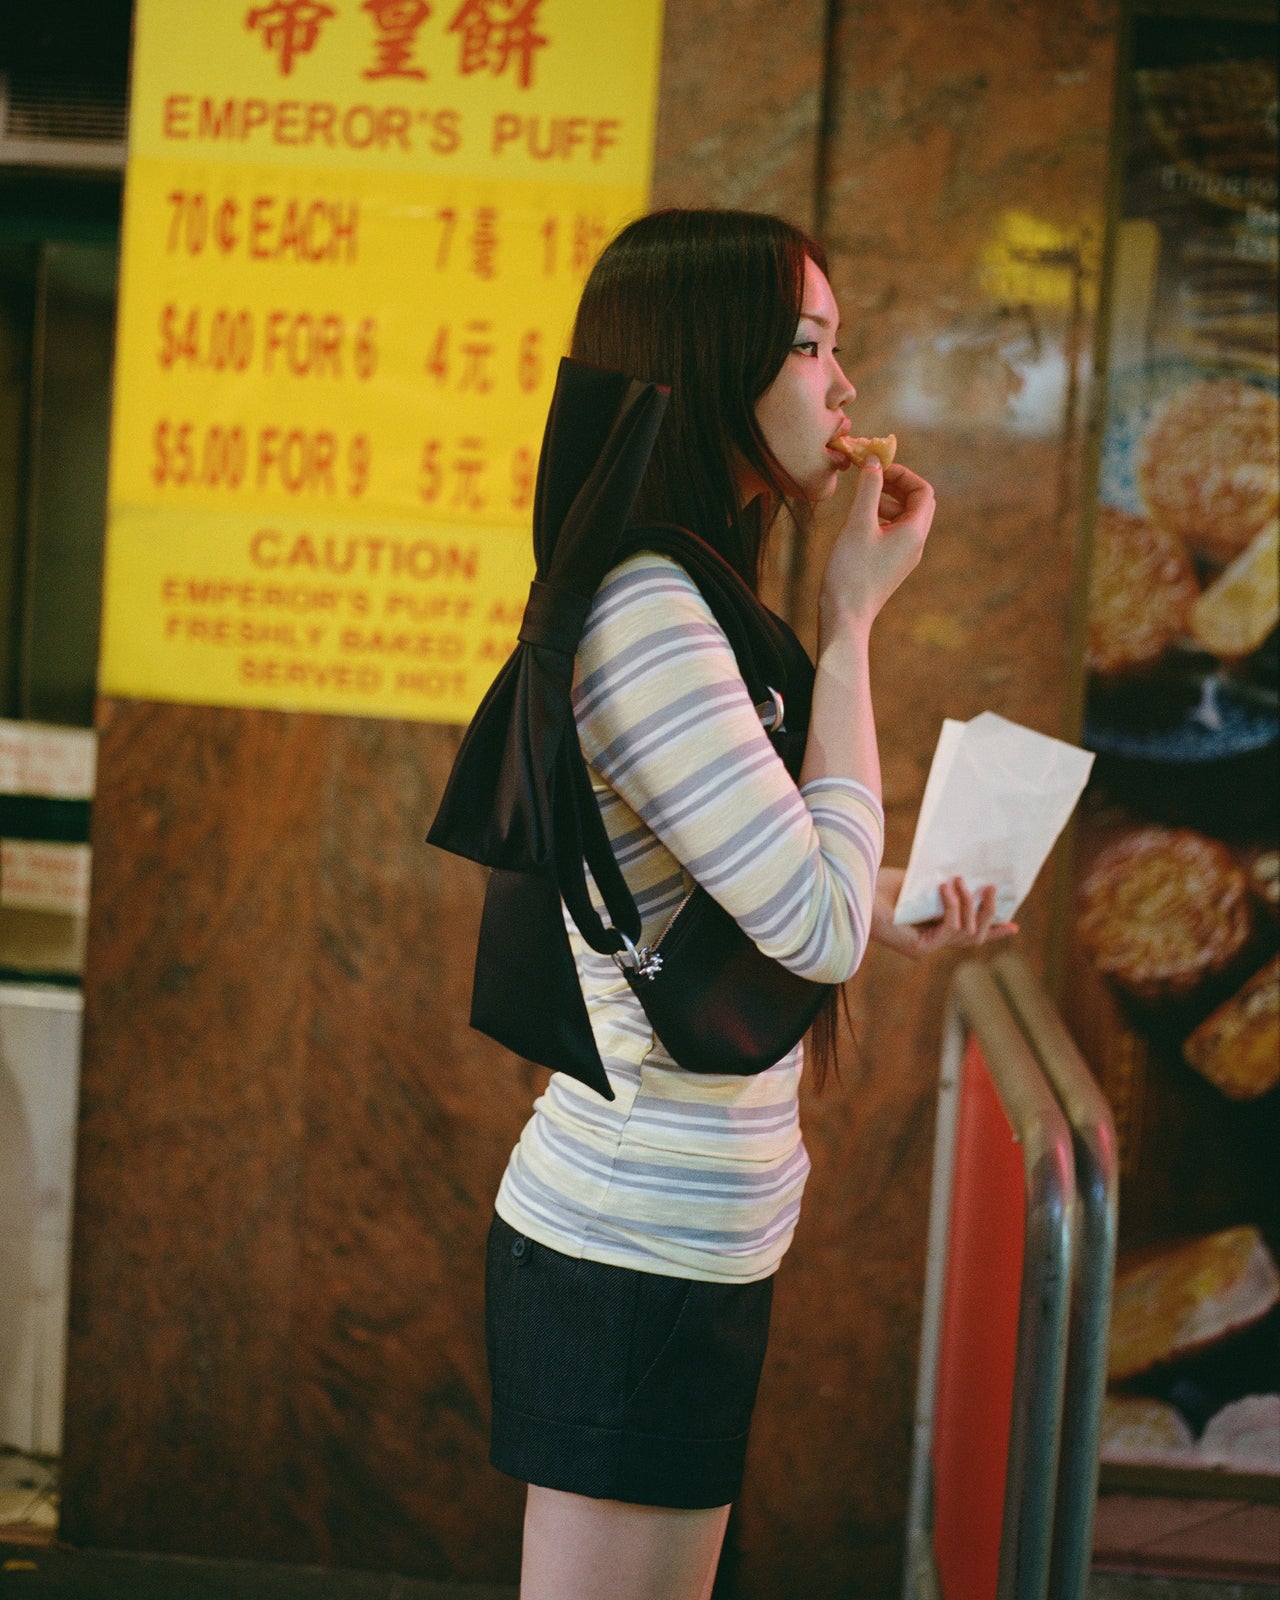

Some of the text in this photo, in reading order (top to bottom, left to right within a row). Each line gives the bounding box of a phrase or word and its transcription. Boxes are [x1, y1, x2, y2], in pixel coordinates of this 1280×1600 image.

[162, 95, 622, 163] EMPEROR'S PUFF
[249, 195, 359, 266] EACH
[157, 300, 378, 383] $4.00 FOR 6
[153, 418, 372, 500] $5.00 FOR 9
[250, 527, 479, 585] CAUTION
[164, 613, 324, 652] FRESHLY
[339, 625, 464, 663] BAKED
[385, 591, 476, 624] PUFF
[238, 655, 468, 700] SERVED HOT
